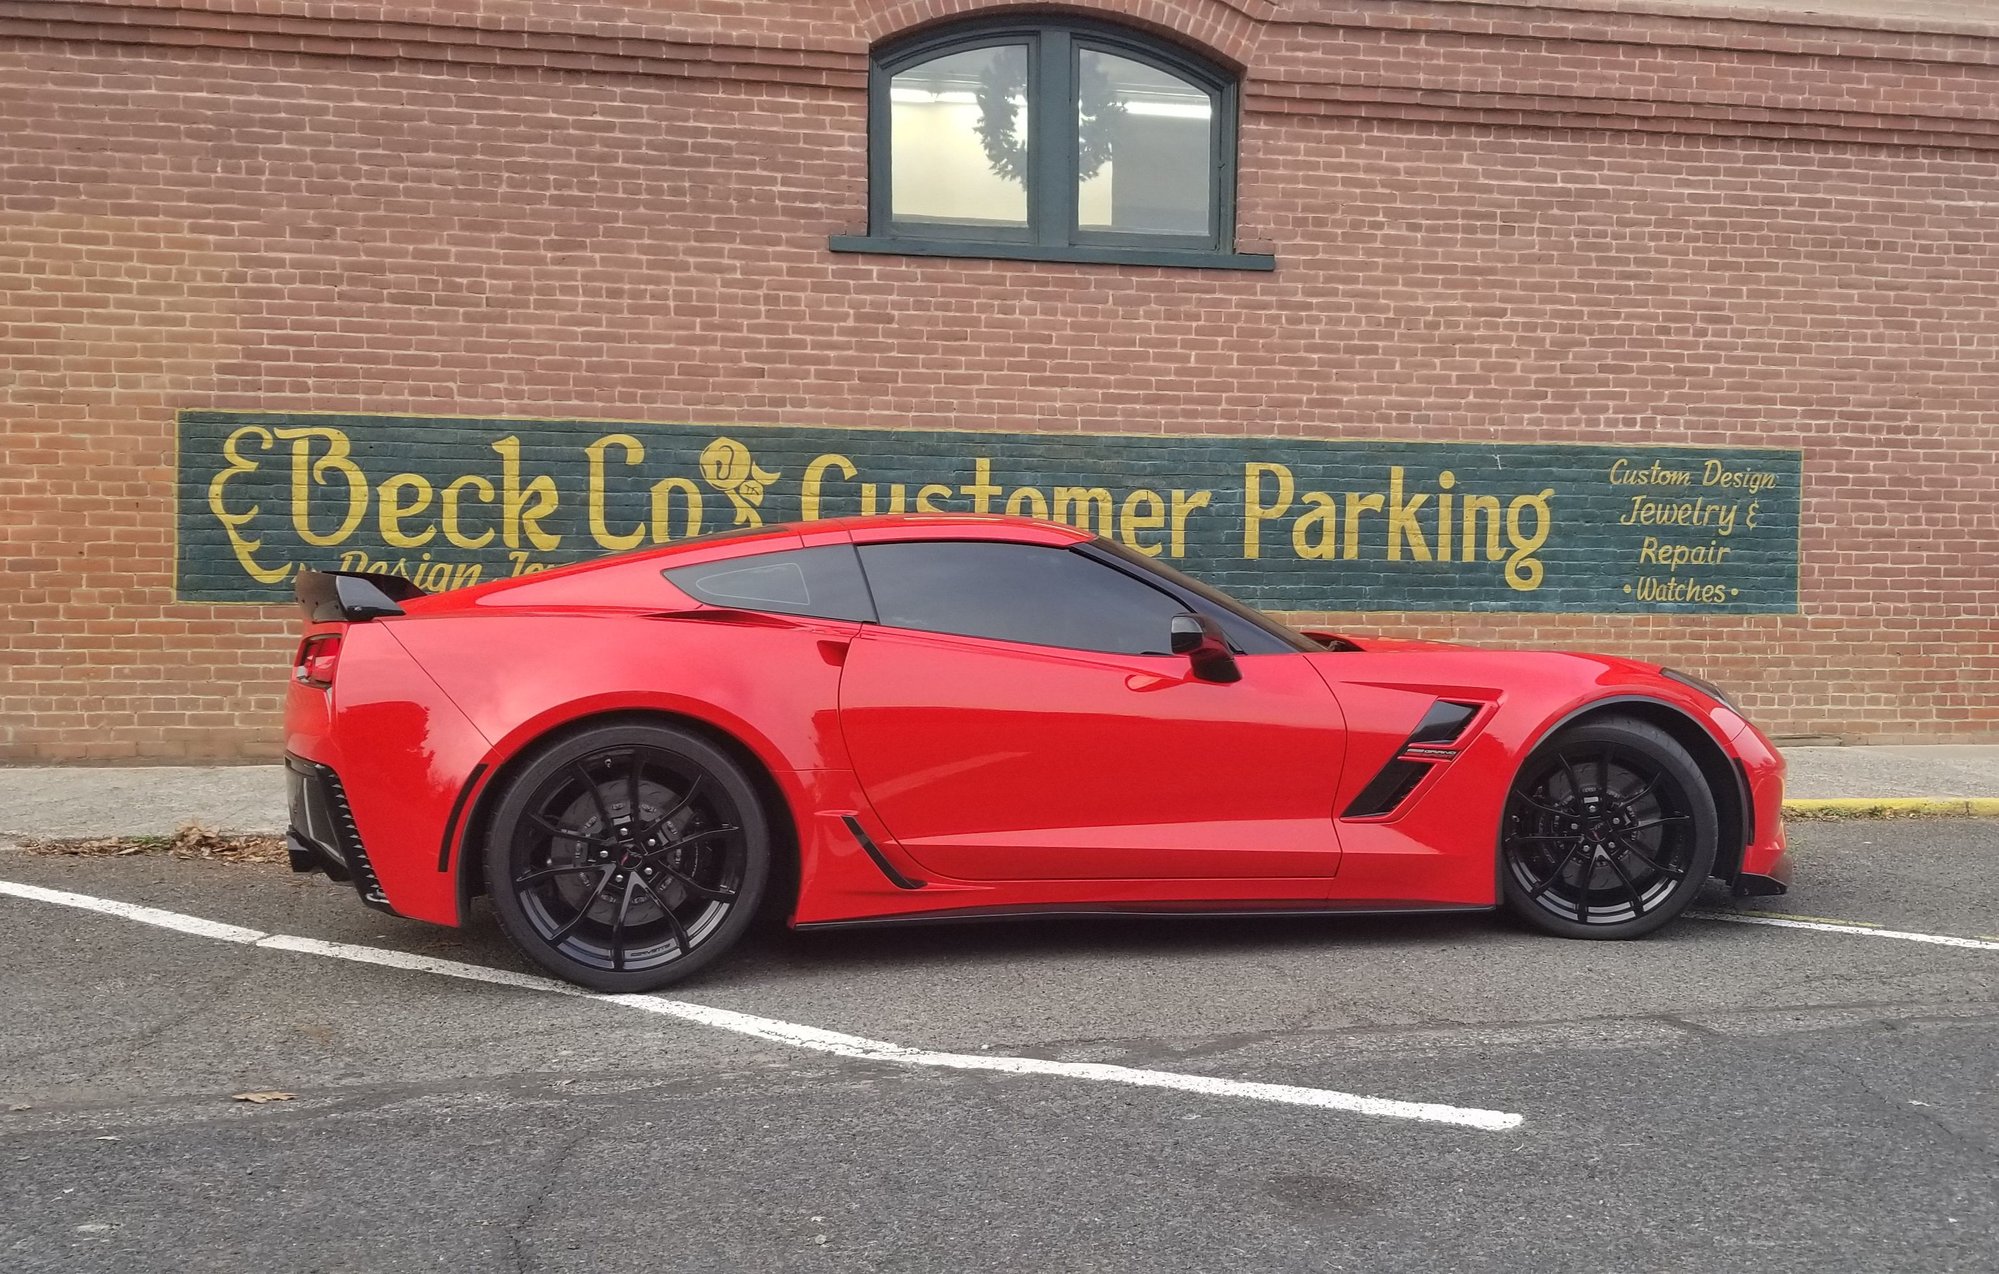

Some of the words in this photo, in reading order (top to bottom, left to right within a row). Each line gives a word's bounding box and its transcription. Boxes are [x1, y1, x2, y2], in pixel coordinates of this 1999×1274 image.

[1609, 458, 1691, 486] Custom
[1702, 459, 1777, 494] Design
[1244, 462, 1556, 592] Parking
[1620, 494, 1738, 536] Jewelry
[1745, 498, 1761, 532] &
[1639, 536, 1732, 572] Repair
